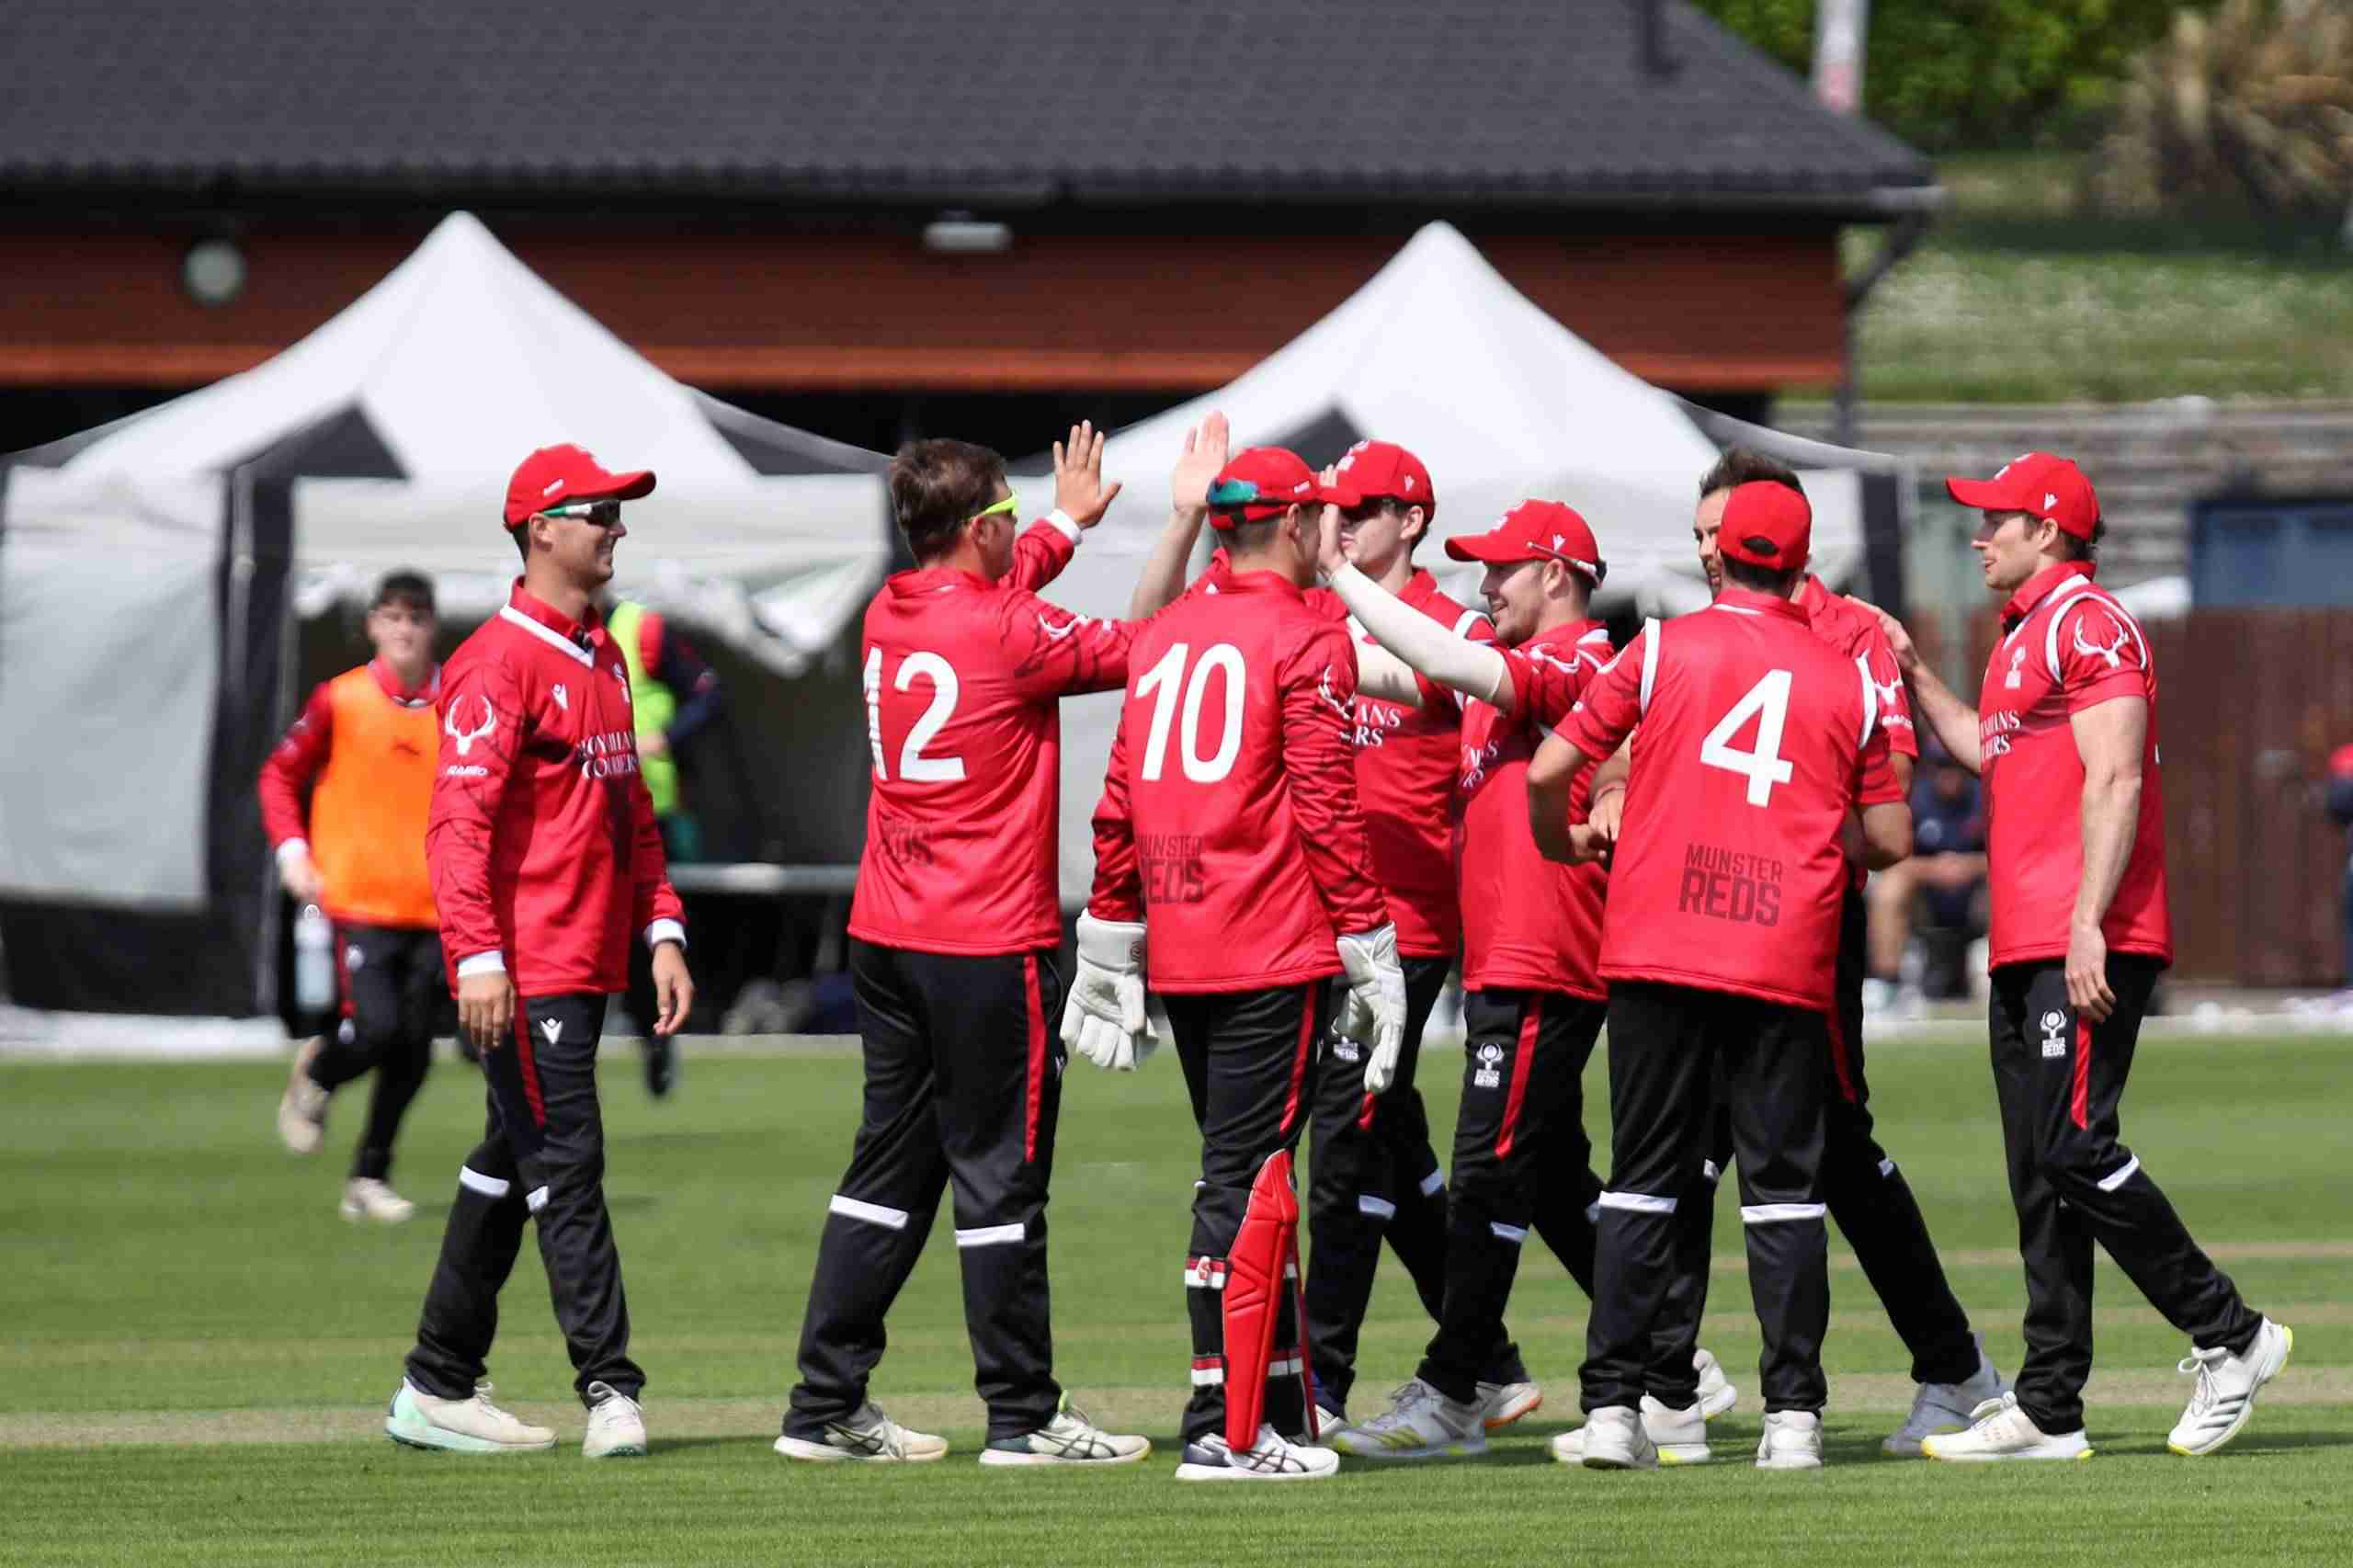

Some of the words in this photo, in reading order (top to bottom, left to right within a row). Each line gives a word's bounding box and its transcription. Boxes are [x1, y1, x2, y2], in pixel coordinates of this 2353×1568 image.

[863, 645, 967, 780] 12
[1134, 642, 1246, 783] 10
[1699, 668, 1794, 809] 4
[1678, 867, 1781, 927] REDS
[1684, 842, 1783, 882] MUNSTER
